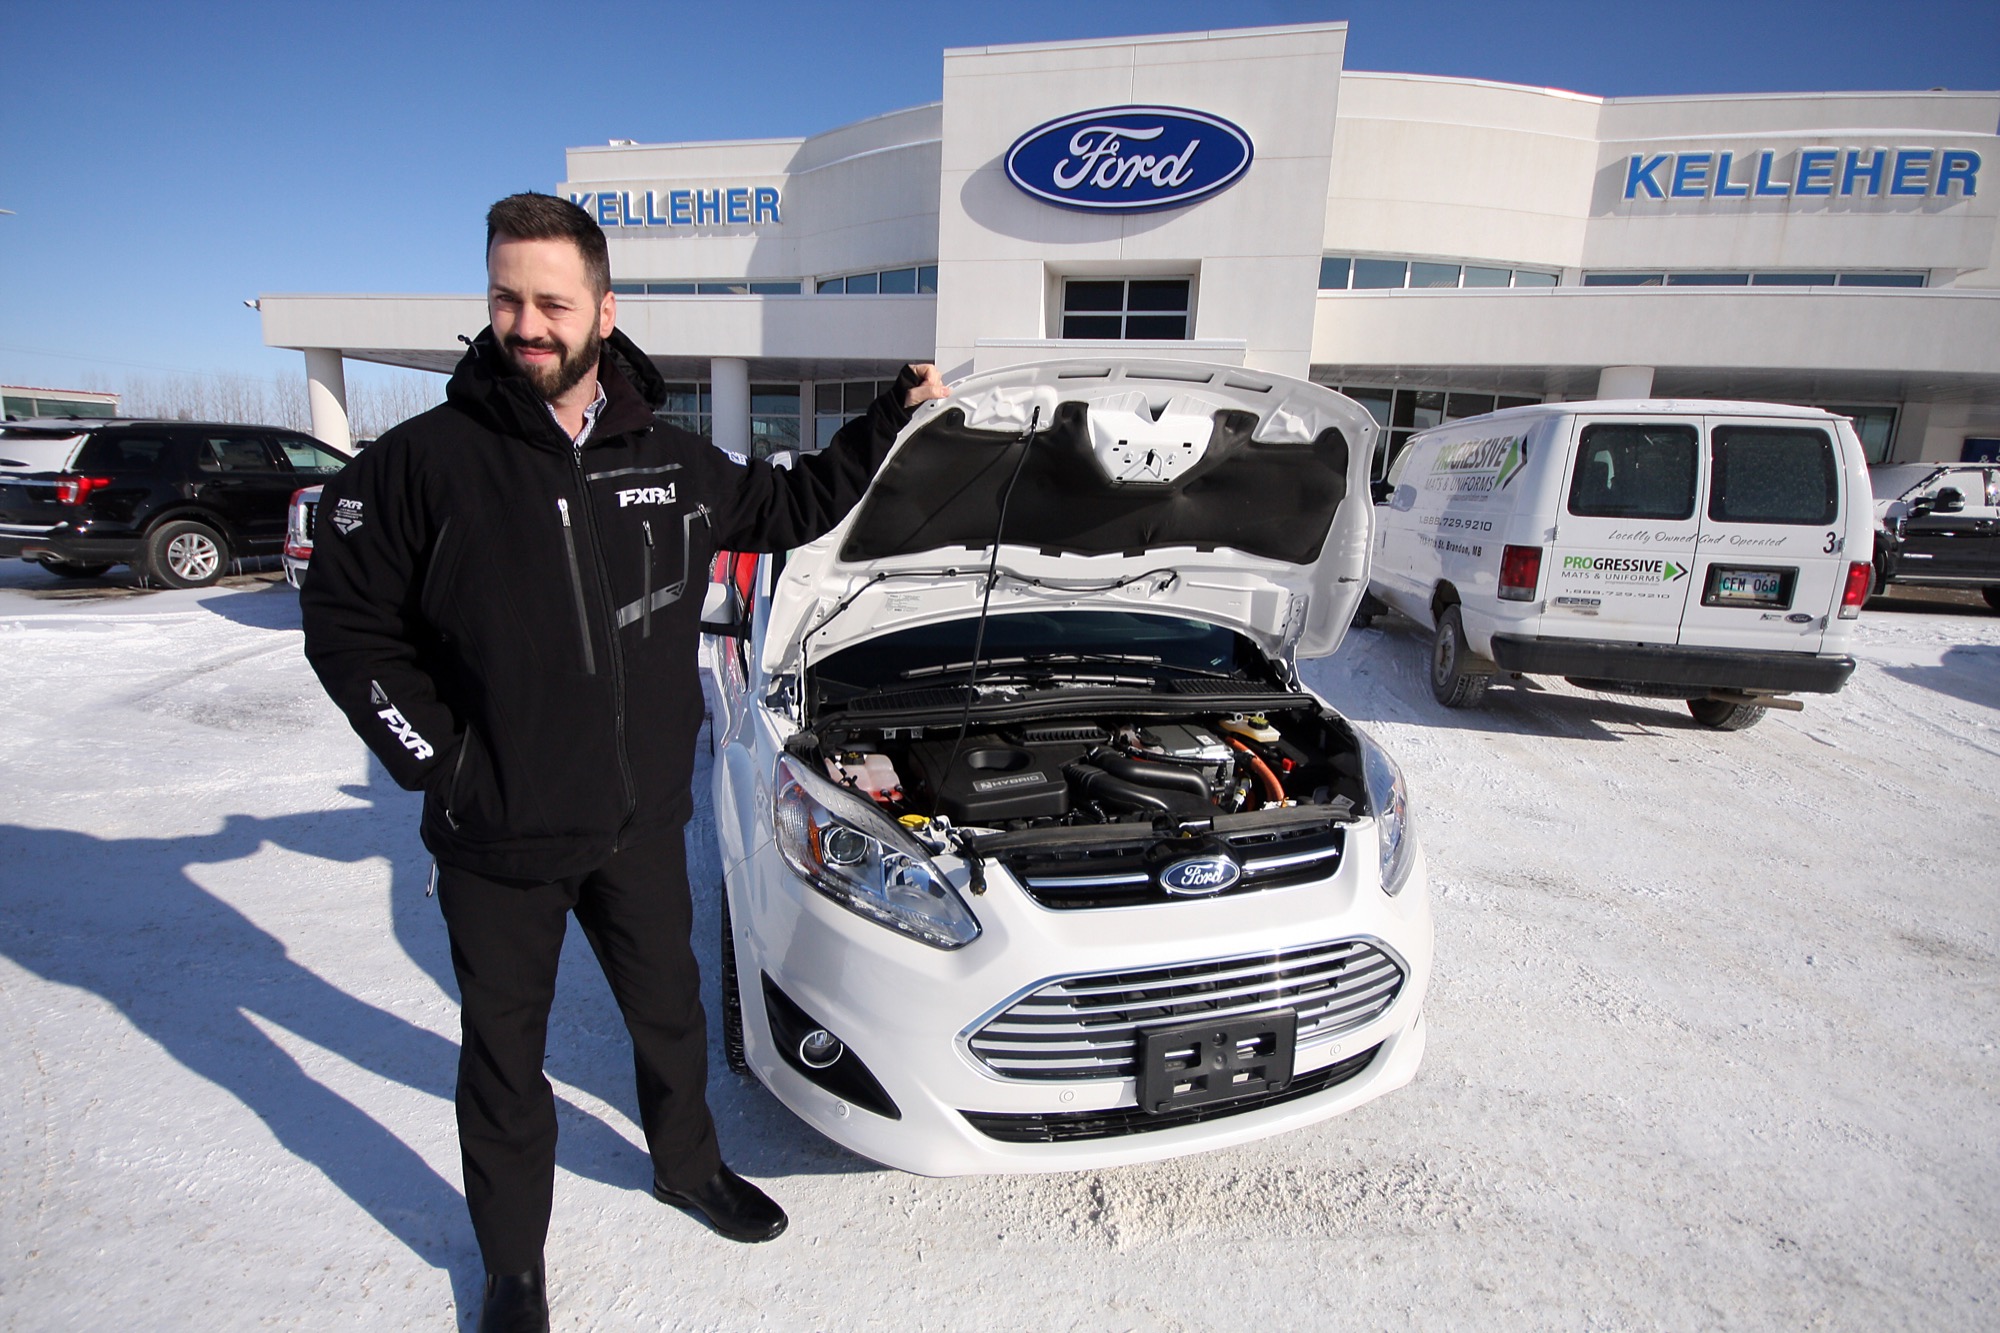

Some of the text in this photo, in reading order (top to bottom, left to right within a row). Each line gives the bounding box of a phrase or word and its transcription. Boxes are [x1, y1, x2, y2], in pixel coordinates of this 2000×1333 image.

[1053, 126, 1200, 189] Ford
[1621, 147, 1982, 200] KELLEHER
[1431, 436, 1514, 472] PROGRESSIVE
[1424, 478, 1442, 492] MATS
[1449, 476, 1496, 492] UNIFORMS
[337, 498, 363, 510] FXR
[1608, 530, 1651, 544] Locally
[1654, 531, 1698, 543] Owned
[1729, 534, 1788, 547] Operated
[1822, 531, 1837, 554] 3
[1563, 556, 1663, 573] PROGRESSIVE
[1561, 570, 1590, 580] MATS
[1605, 573, 1661, 583] UNIFORMS
[1722, 576, 1778, 593] CFM 068
[377, 703, 434, 760] FXR
[992, 775, 1040, 788] HYBRID
[1181, 862, 1224, 886] Ford
